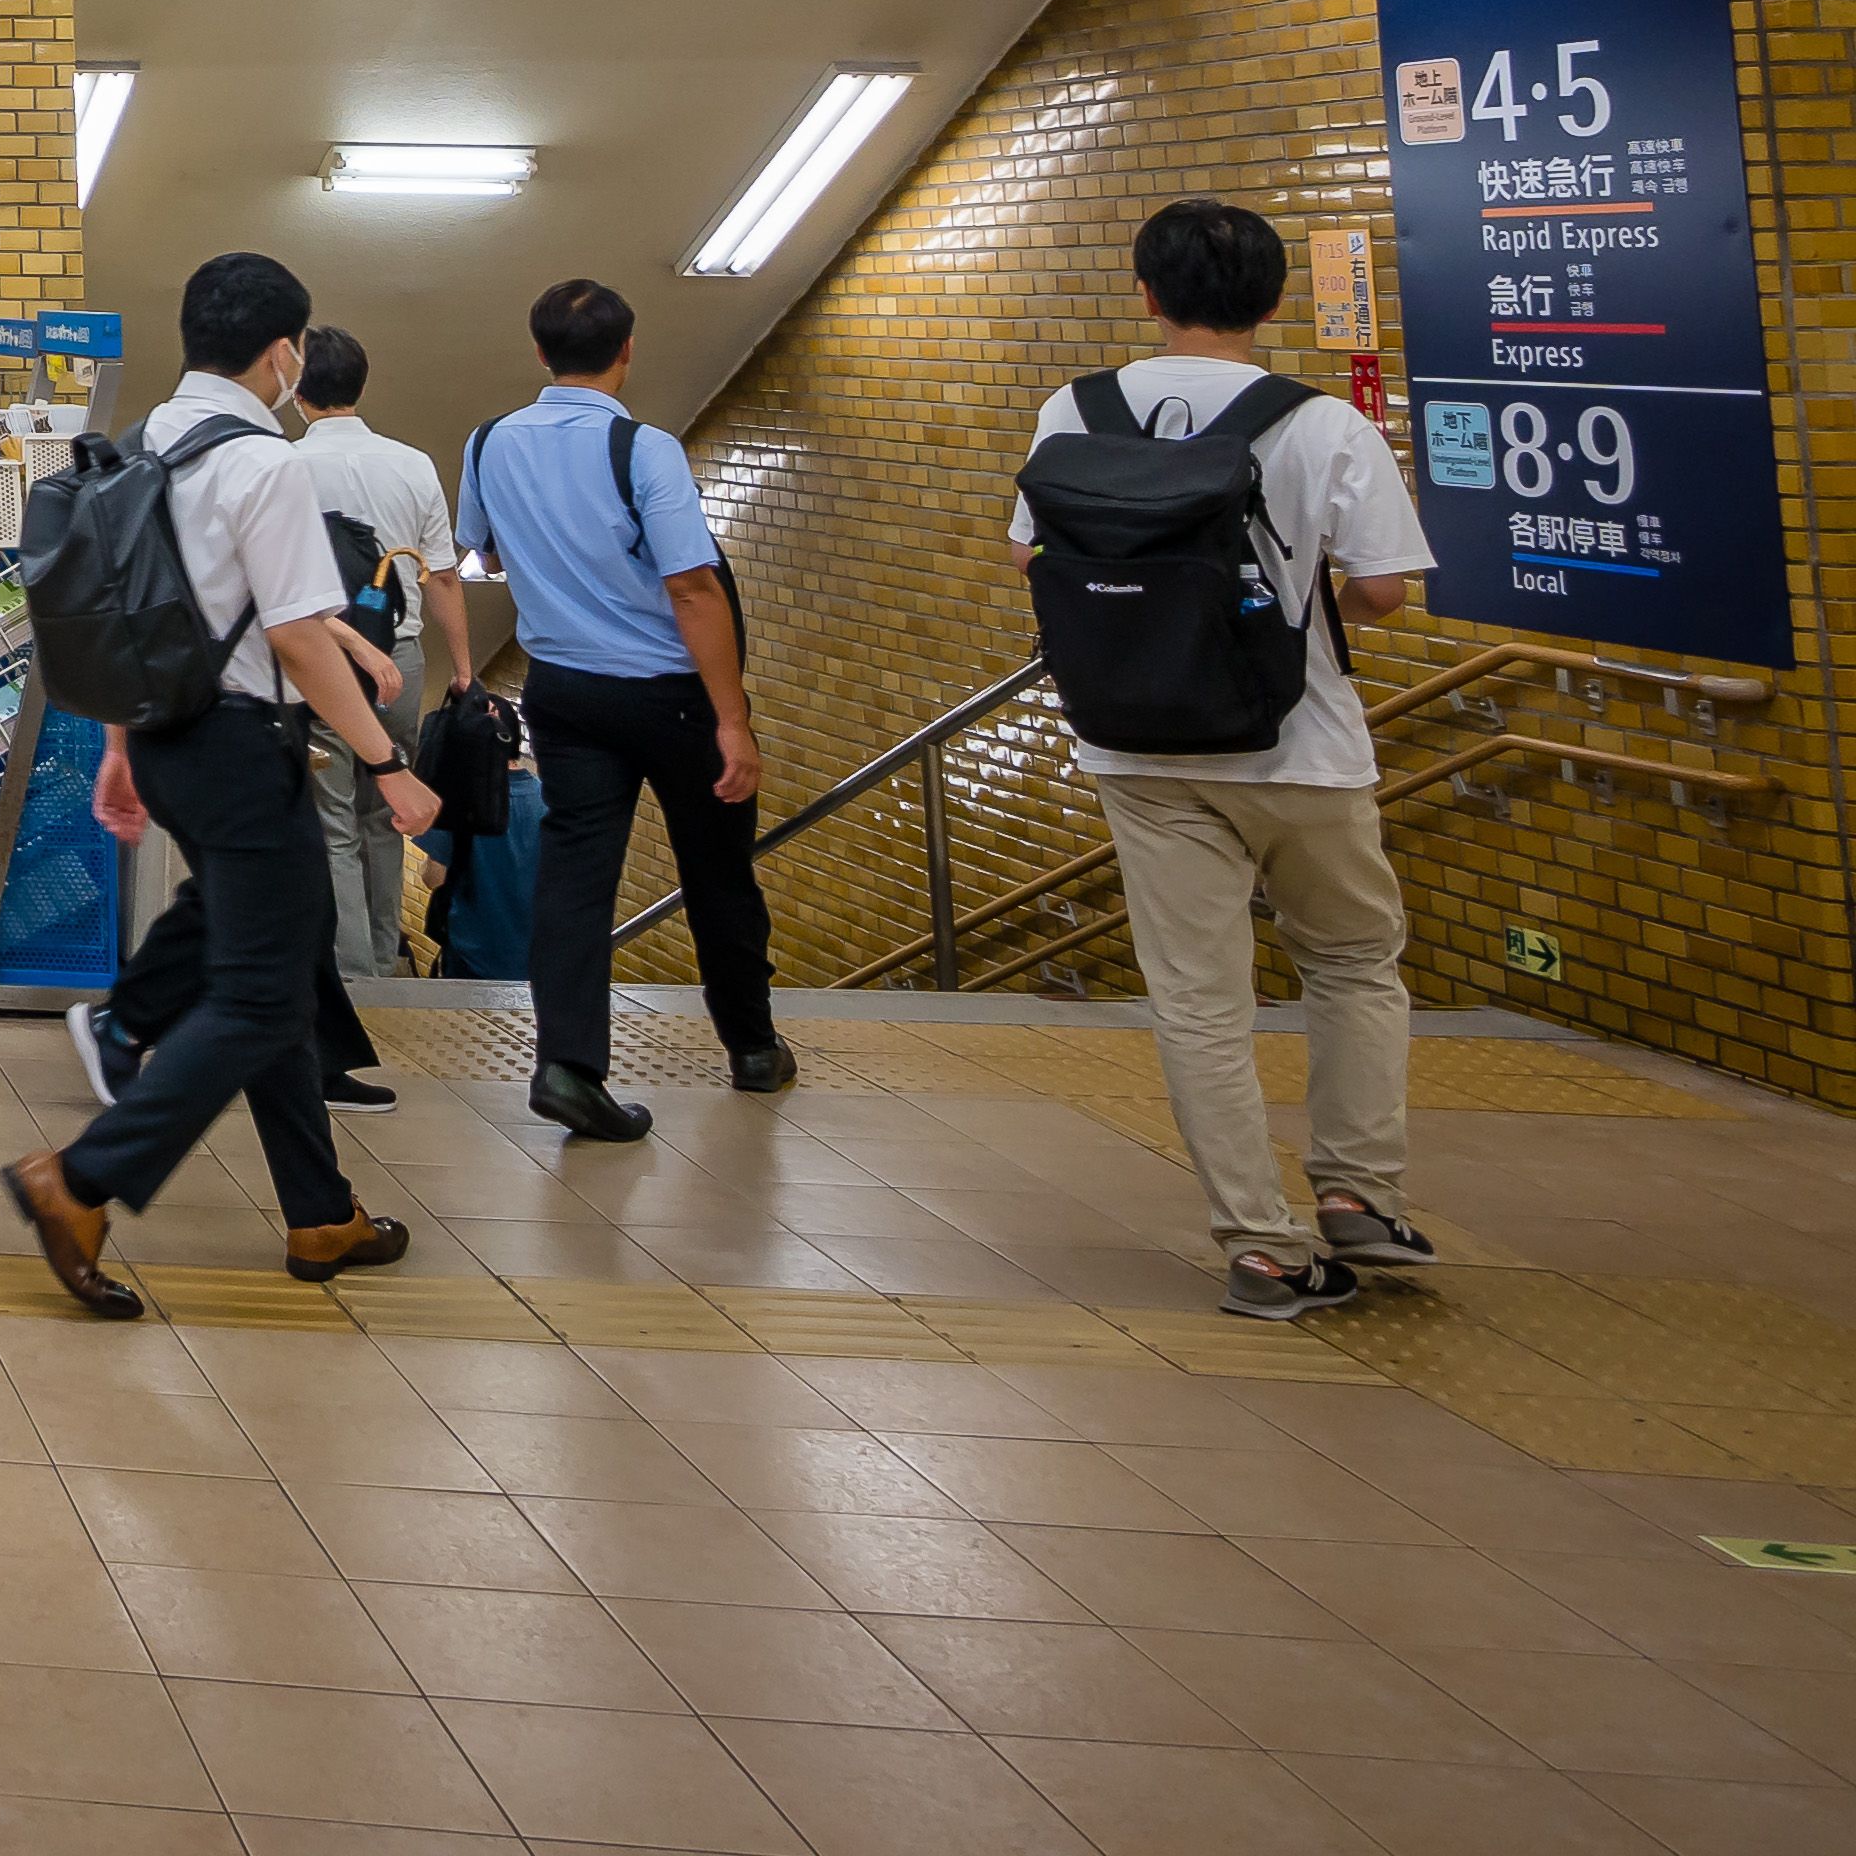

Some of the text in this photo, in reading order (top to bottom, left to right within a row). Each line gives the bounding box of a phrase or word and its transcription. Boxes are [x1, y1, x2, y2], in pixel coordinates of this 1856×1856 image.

[1478, 153, 1616, 203] 快速急行
[1481, 219, 1660, 257] Rapid Express
[1487, 273, 1553, 319] 急行
[1491, 337, 1585, 372] Express
[1508, 511, 1628, 557] 各駅停車
[1512, 565, 1568, 598] Local
